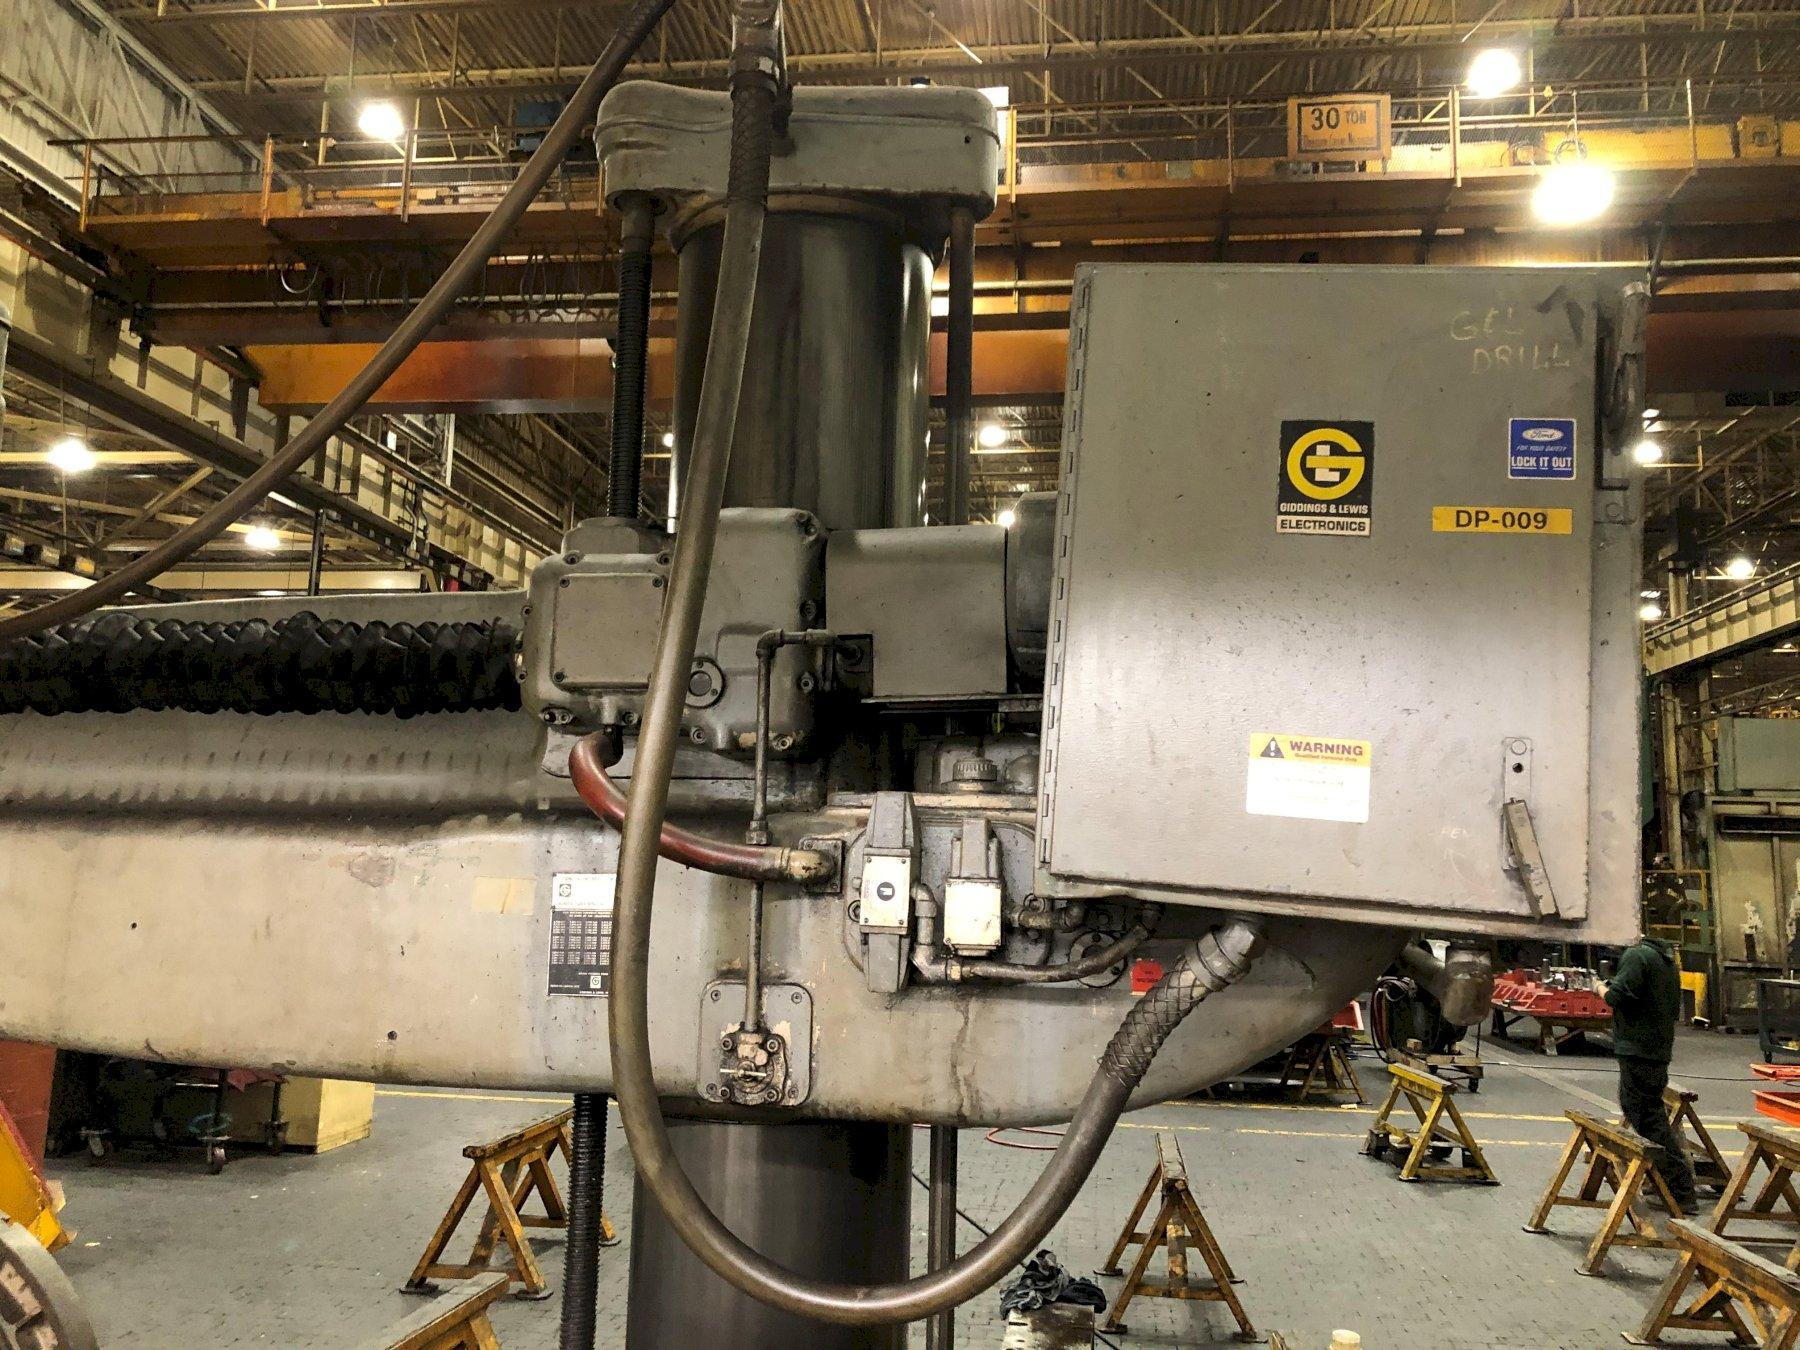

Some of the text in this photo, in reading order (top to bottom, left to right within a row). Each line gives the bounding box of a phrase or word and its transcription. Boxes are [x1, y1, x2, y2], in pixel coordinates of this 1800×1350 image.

[1311, 107, 1367, 131] 30 TON
[1472, 342, 1570, 375] DRILL
[1511, 455, 1573, 468] LOCK IT OUT
[1280, 502, 1369, 515] GIDDINGS & LEWIS
[1280, 519, 1367, 532] ELECTRONICS
[1456, 510, 1548, 530] DP-009
[1289, 740, 1363, 756] WARNING
